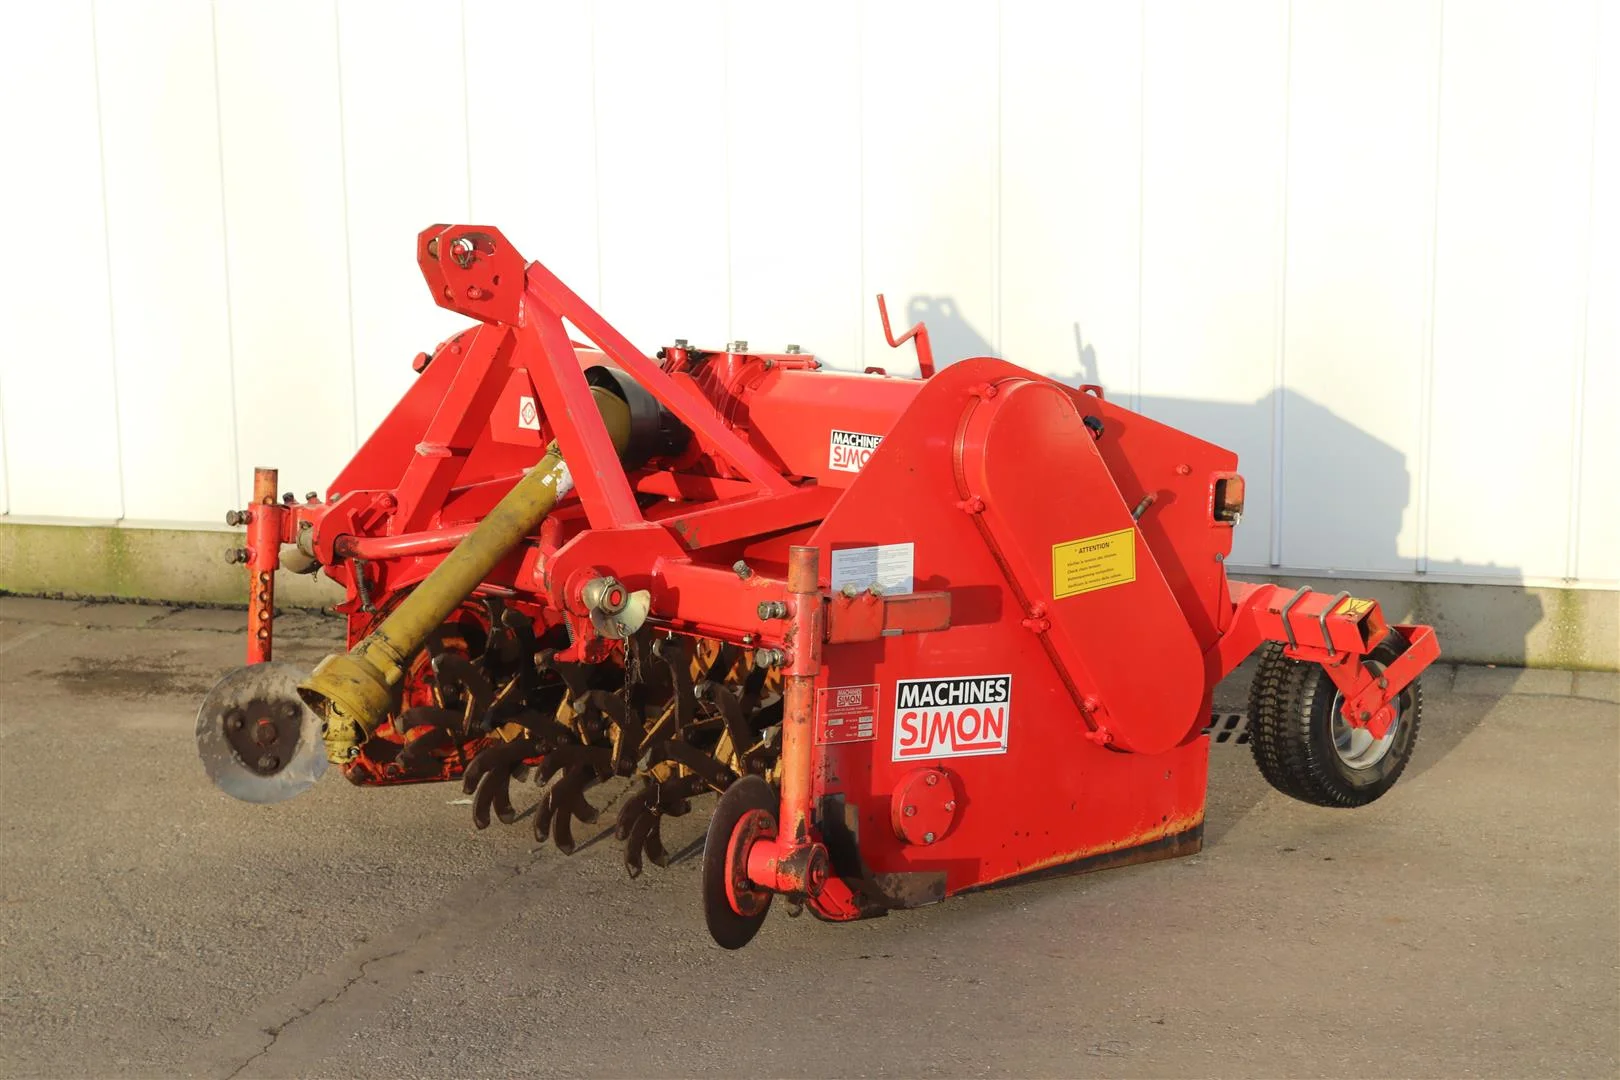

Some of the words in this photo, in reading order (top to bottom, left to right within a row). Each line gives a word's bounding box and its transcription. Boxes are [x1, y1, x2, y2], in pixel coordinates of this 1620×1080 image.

[833, 431, 883, 449] MACHINE
[833, 445, 872, 469] SIMO
[1078, 541, 1110, 554] ATTENTION
[838, 695, 861, 706] SIMON
[900, 679, 1006, 708] MACHINES
[899, 706, 1004, 757] SIMON
